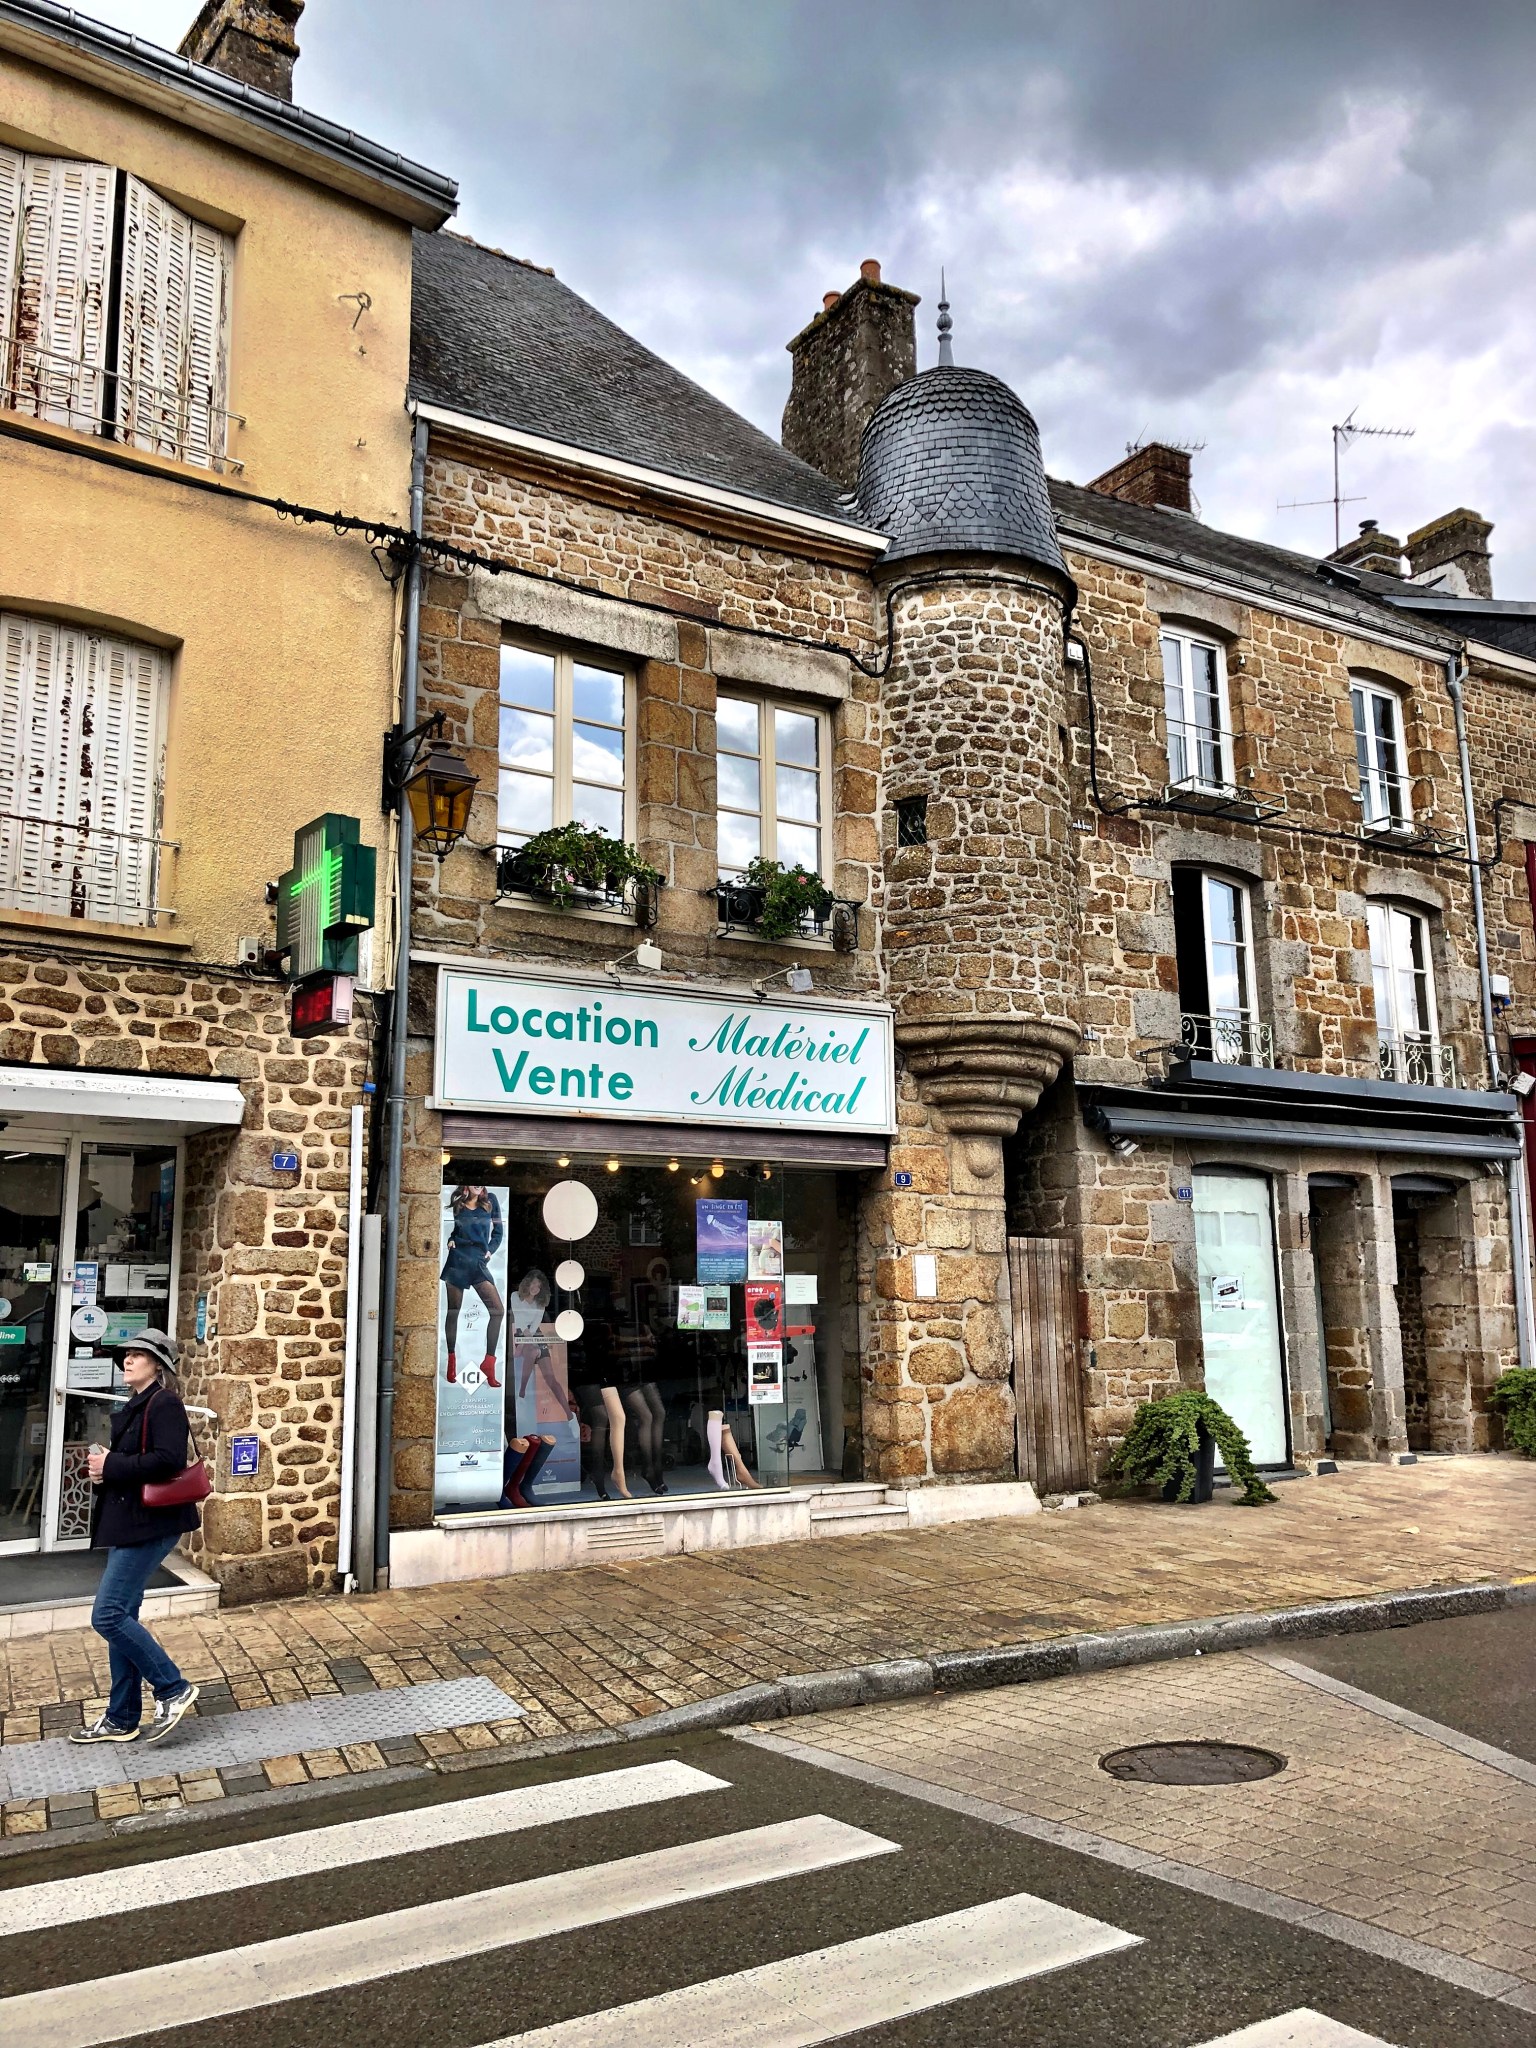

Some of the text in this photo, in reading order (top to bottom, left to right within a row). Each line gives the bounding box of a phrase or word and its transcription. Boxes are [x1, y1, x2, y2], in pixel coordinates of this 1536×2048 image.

[466, 987, 660, 1049] Location
[688, 1011, 871, 1066] Matériel
[491, 1047, 635, 1102] Vente
[690, 1064, 868, 1116] Médical
[281, 1156, 289, 1167] 7
[462, 1371, 480, 1384] ICI
